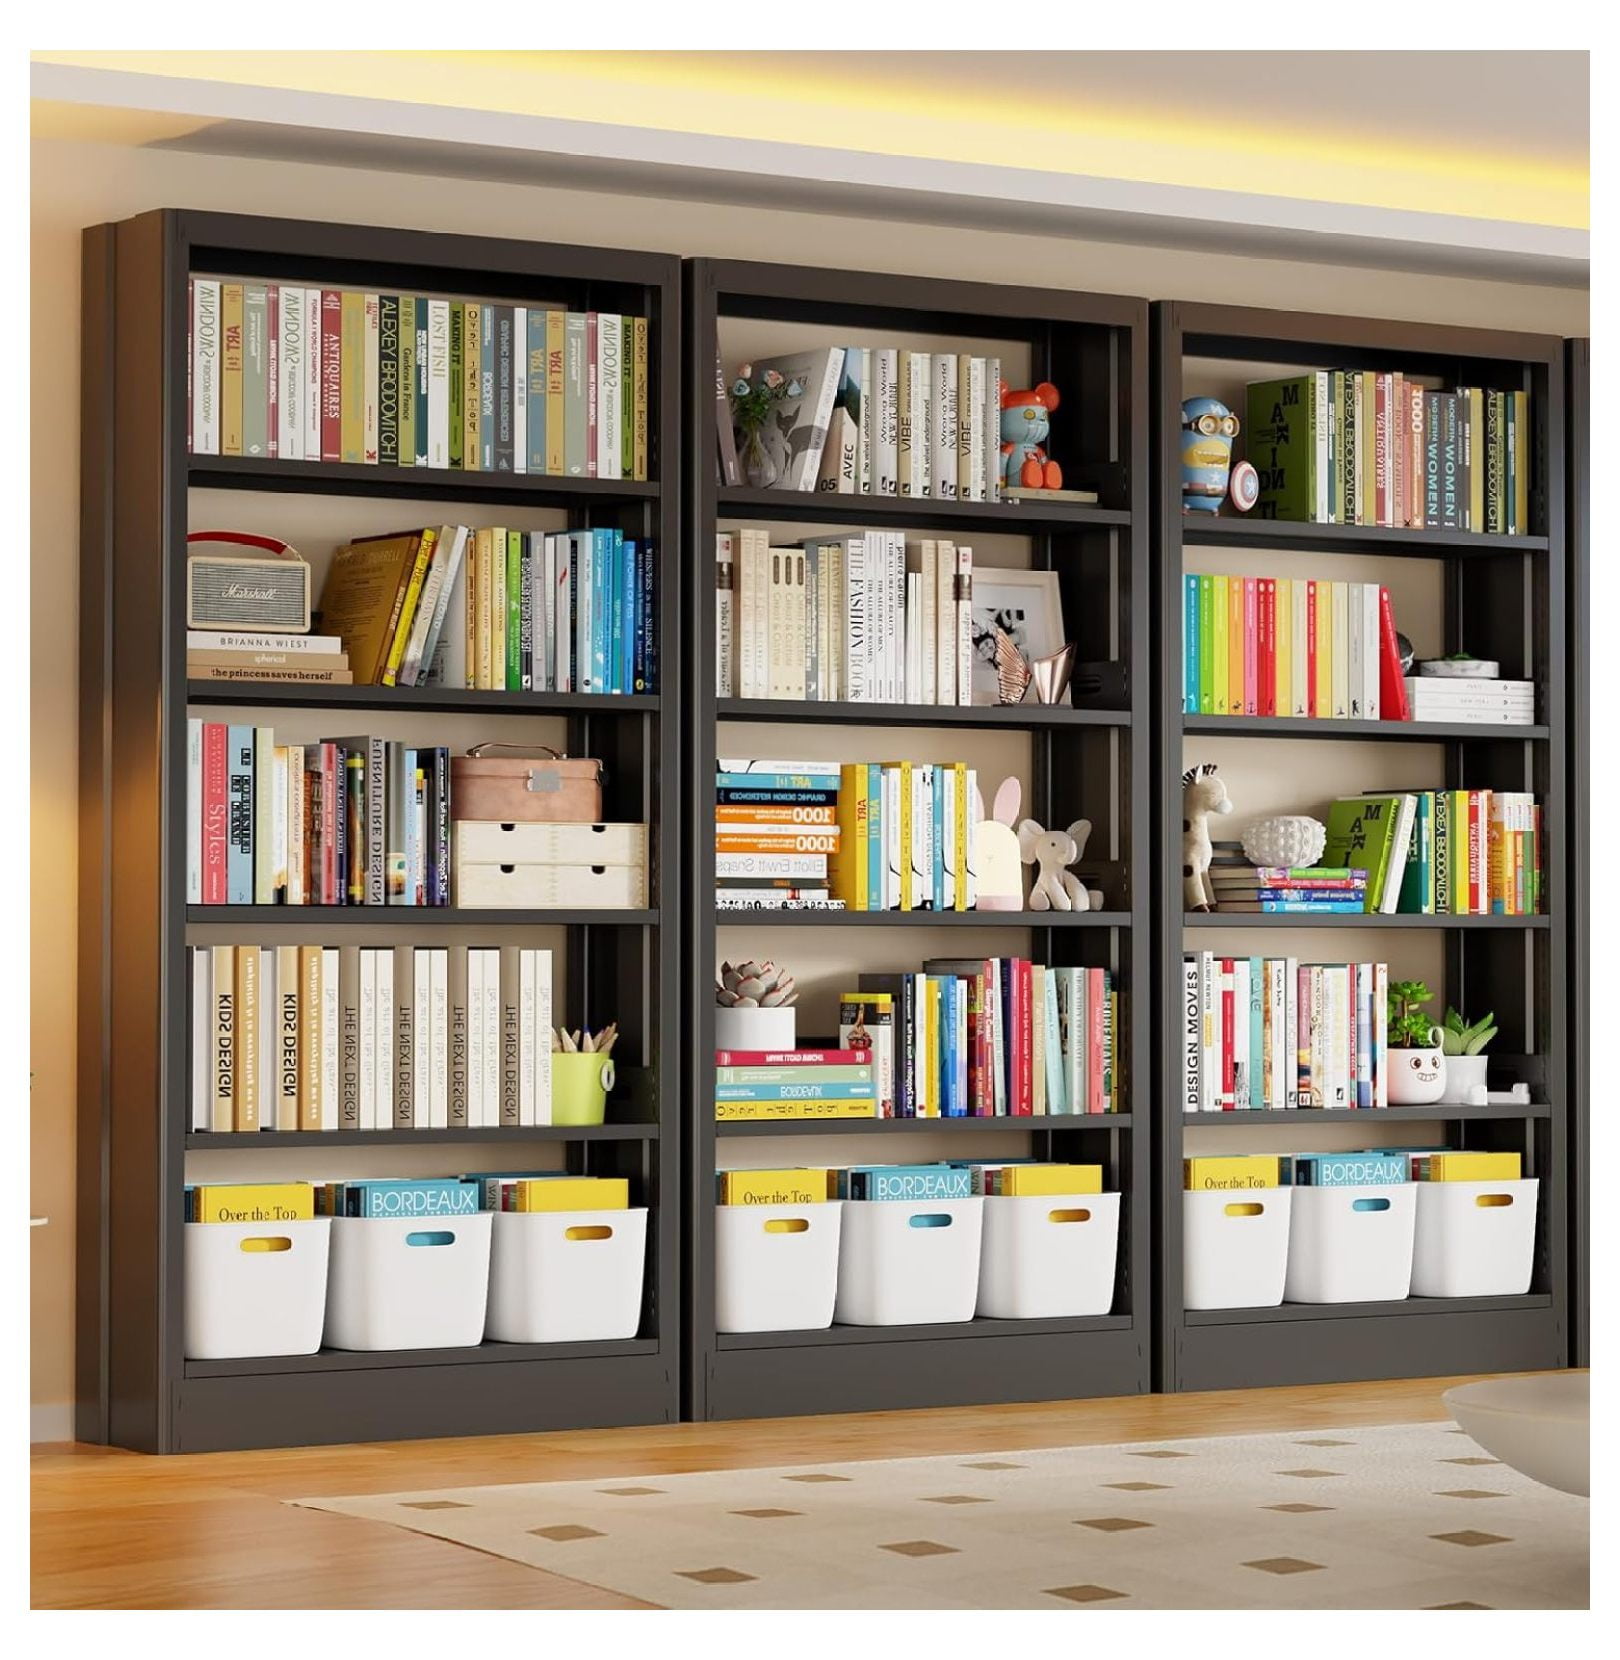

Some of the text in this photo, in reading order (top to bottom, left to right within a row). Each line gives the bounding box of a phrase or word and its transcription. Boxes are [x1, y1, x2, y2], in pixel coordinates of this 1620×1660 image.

[452, 310, 460, 352] MAKING
[330, 334, 340, 418] ANTIQUAIRES
[381, 300, 396, 455] ALEXEY BRODOVITCH
[901, 416, 911, 452] VIBE
[962, 420, 971, 456] VIBE
[843, 444, 854, 480] AVEC
[1488, 390, 1496, 526] ALEXEY BRODOVITCH
[820, 478, 836, 492] 05
[1428, 443, 1438, 514] WOMEN
[1445, 444, 1454, 516] WOMEN
[850, 579, 864, 649] FASHION
[220, 638, 308, 648] BRIANNA WIEST
[231, 775, 240, 846] LE GRAND
[241, 748, 250, 854] LE CORBUSIER
[204, 804, 226, 864] Styles
[1188, 972, 1198, 1104] DESIGN MOVES
[878, 1175, 968, 1197] BORDEAUX
[1204, 1176, 1230, 1189] Over
[1230, 1177, 1244, 1188] the
[1322, 1162, 1403, 1181] BORDEAUX
[219, 1206, 297, 1221] Over the Top
[372, 1190, 474, 1212] BORDEAUX
[744, 1192, 770, 1204] Over
[772, 1192, 788, 1203] the
